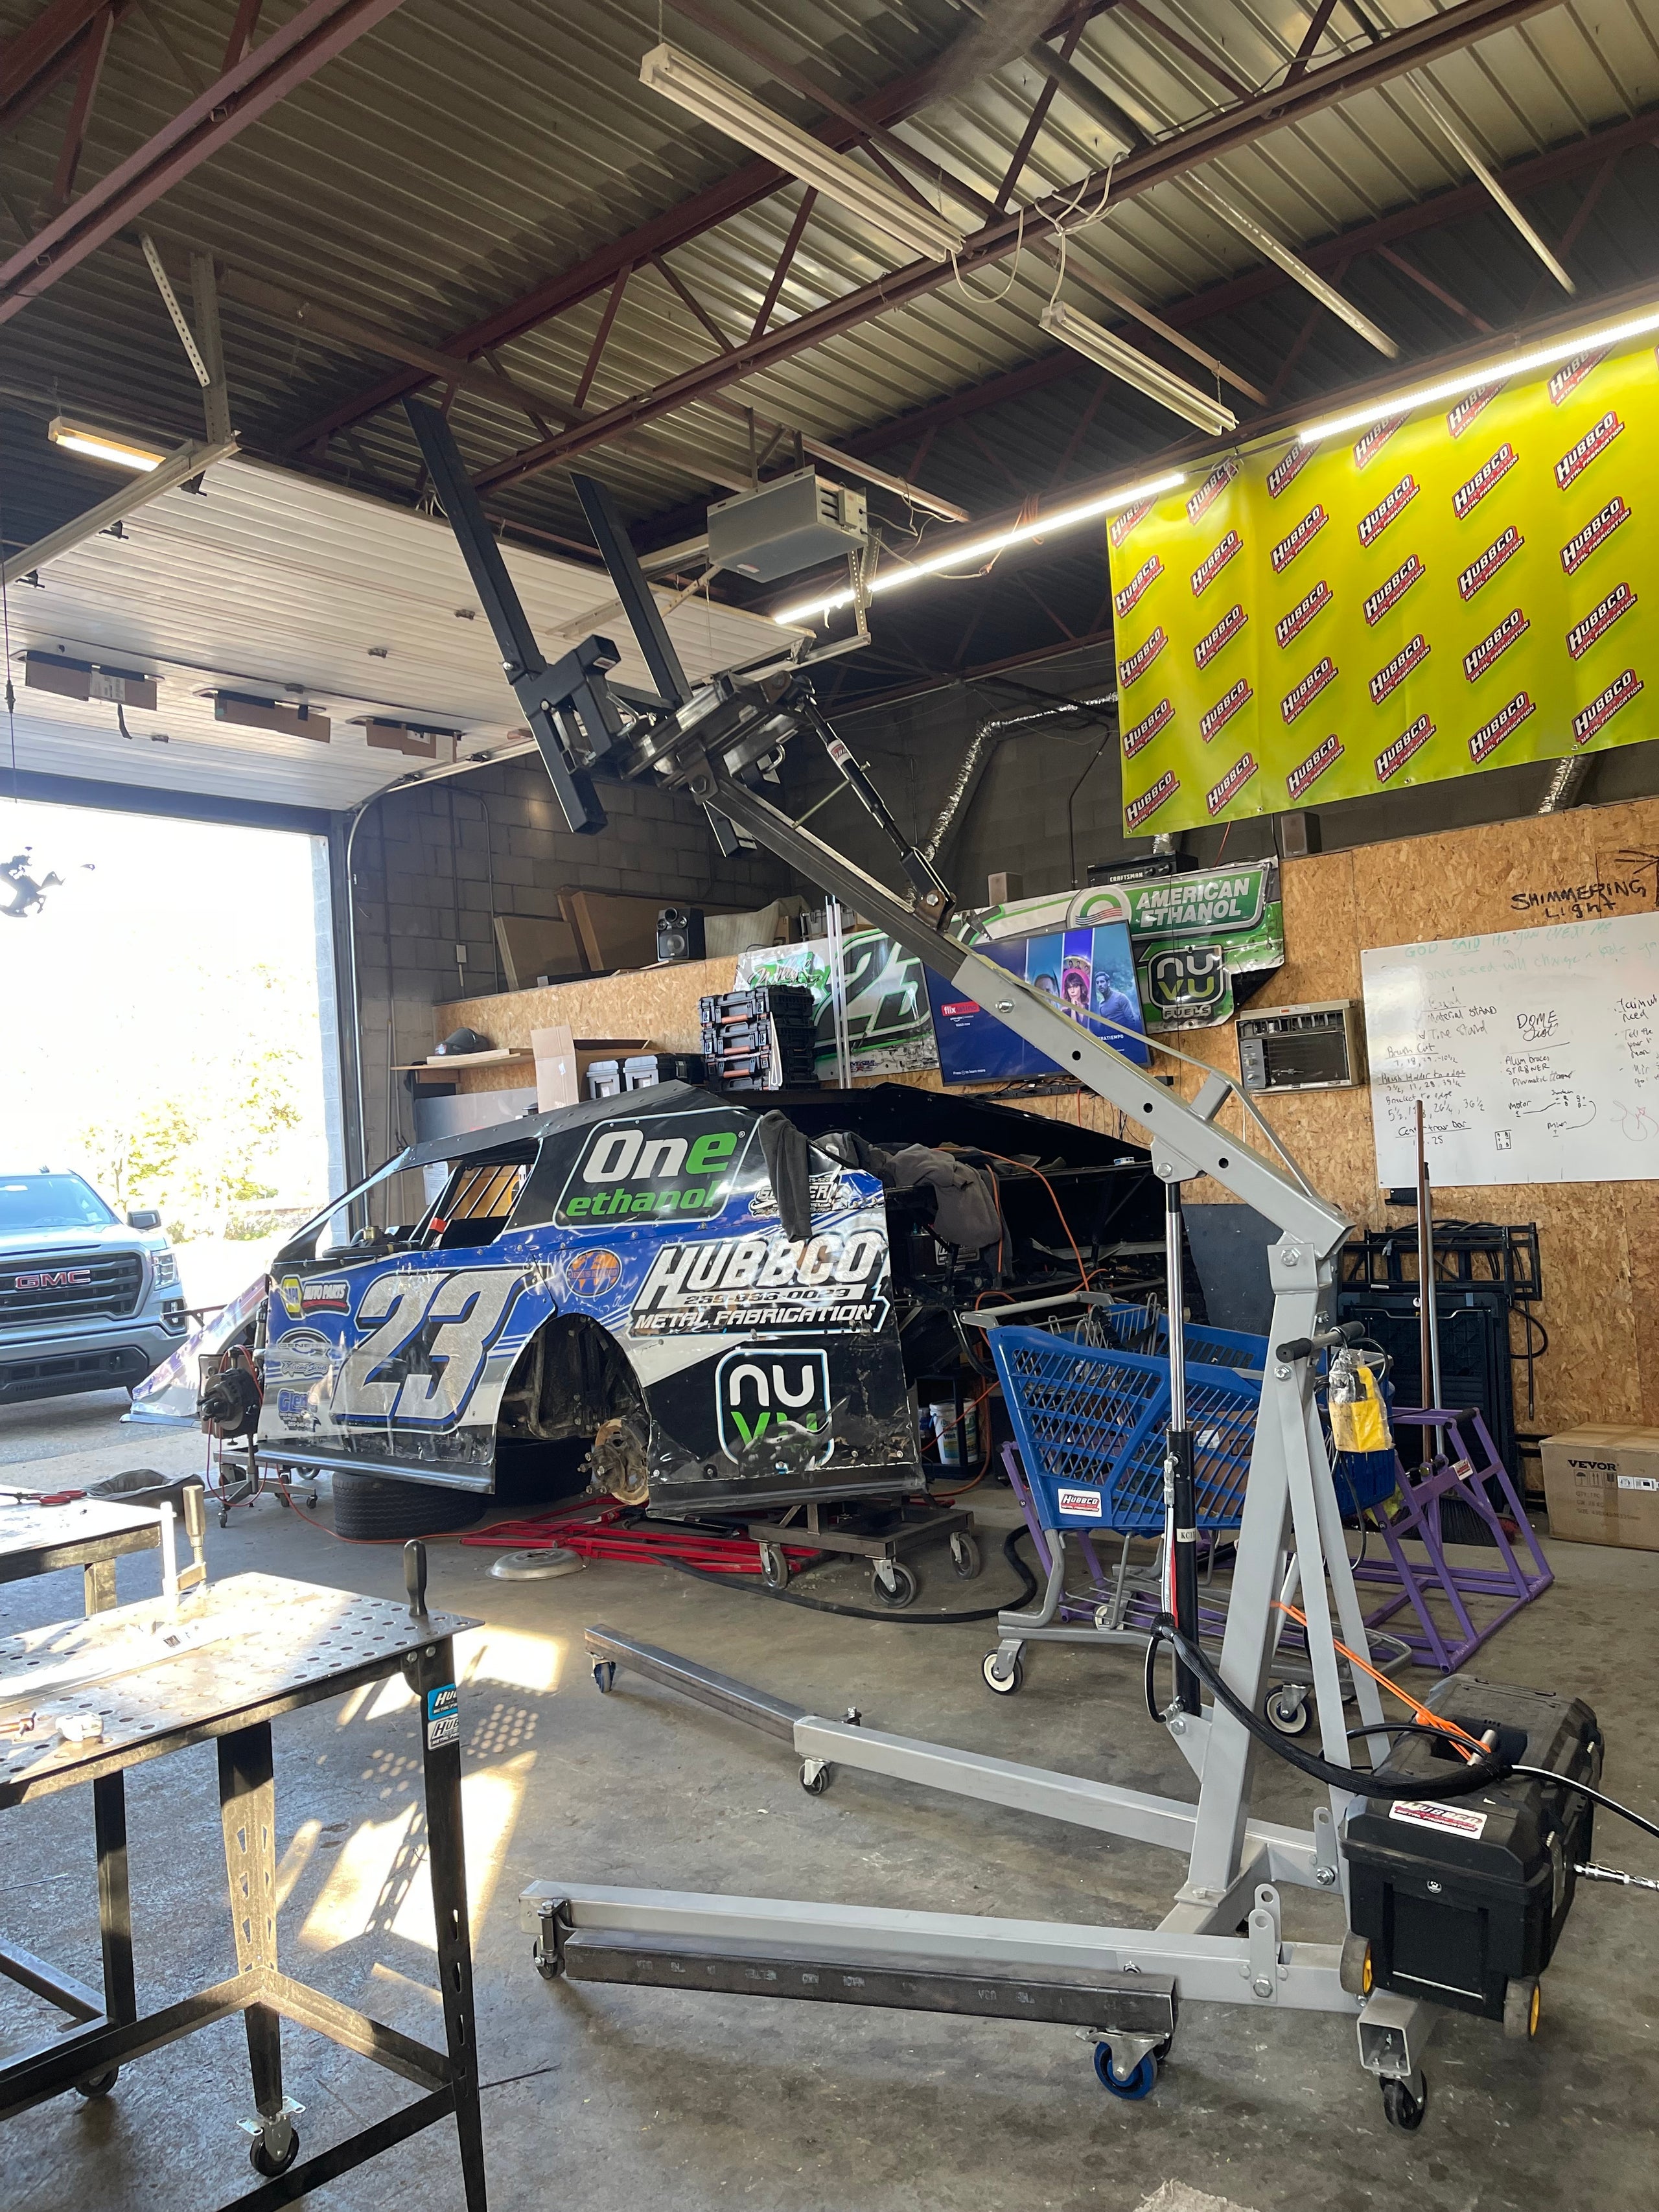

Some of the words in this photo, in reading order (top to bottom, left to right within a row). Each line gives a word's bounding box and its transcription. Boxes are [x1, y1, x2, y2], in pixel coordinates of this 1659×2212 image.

[1549, 352, 1588, 398] HUBB
[1448, 385, 1486, 432] HUBB
[1355, 419, 1389, 461] HUBB
[1557, 414, 1613, 481] HUBBCO
[1583, 426, 1623, 468] FABRICATION
[1269, 443, 1305, 491] HUBB
[1455, 447, 1508, 511] HUBBCO
[1479, 458, 1517, 498] FABRICATION
[1111, 500, 1142, 541] HUBB
[1359, 477, 1410, 539] HUBBCO
[1382, 488, 1418, 528] FABRICATION
[1272, 507, 1319, 566] HUBBCO
[1294, 518, 1328, 555] FABRICATION
[1562, 500, 1620, 566] HUBBCO
[1588, 511, 1630, 553] FABRICATION
[1192, 533, 1235, 589] HUBBCO
[1212, 542, 1242, 579] FABRICATION
[1460, 529, 1514, 593] HUBBCO
[1485, 540, 1523, 581] FABRICATION
[1116, 558, 1155, 611] HUBBCO
[1364, 557, 1415, 619] HUBBCO
[1388, 568, 1424, 607] FABRICATION
[1277, 583, 1323, 642] HUBBCO
[1298, 594, 1332, 631] FABRICATION
[1568, 585, 1626, 652] HUBBCO
[1595, 597, 1636, 639] FABRICATION
[1120, 629, 1160, 682] HUBBCO
[1196, 607, 1240, 662] HUBBCO
[1216, 617, 1247, 652] FABRICATION
[1465, 611, 1520, 675] HUBBCO
[1490, 622, 1529, 663] FABRICATION
[1304, 669, 1338, 706] FABRICATION
[1371, 636, 1421, 697] HUBBCO
[1394, 647, 1430, 686] FABRICATION
[1201, 681, 1244, 736] HUBBCO
[1221, 691, 1252, 725] FABRICATION
[1282, 660, 1329, 717] HUBBCO
[1573, 671, 1632, 737] HUBBCO
[1601, 682, 1643, 725] FABRICATION
[1124, 701, 1166, 752] HUBBCO
[1470, 693, 1526, 756] HUBBCO
[1496, 704, 1535, 744] FABRICATION
[1288, 736, 1336, 793] HUBBCO
[1310, 746, 1344, 782] FABRICATION
[1376, 716, 1426, 776] HUBBCO
[1399, 727, 1435, 764] FABRICATION
[1126, 773, 1172, 826] HUBBCO
[1207, 755, 1250, 810] HUBBCO
[1227, 765, 1258, 799] FABRICATION
[1109, 872, 1143, 883] CRAFTSMAN
[1135, 878, 1250, 910] AMERICAN
[1511, 879, 1647, 910] SHIMMERING
[1140, 899, 1242, 928] ETHANOL
[1405, 943, 1438, 959] GOD
[1164, 1007, 1211, 1019] FUELS
[1517, 1010, 1559, 1029] DOME
[583, 1130, 737, 1183] One
[566, 1180, 721, 1217] ethanol
[16, 1270, 91, 1290] GMC
[634, 1231, 884, 1310] HUBBCO
[303, 1285, 323, 1300] AUTO
[323, 1284, 347, 1299] PARTS
[634, 1311, 709, 1330] METAL
[713, 1305, 876, 1326] FABRICATION
[329, 1269, 533, 1419] 23
[1568, 1460, 1617, 1471] VEVOR
[1063, 1495, 1098, 1505] HUBBCO
